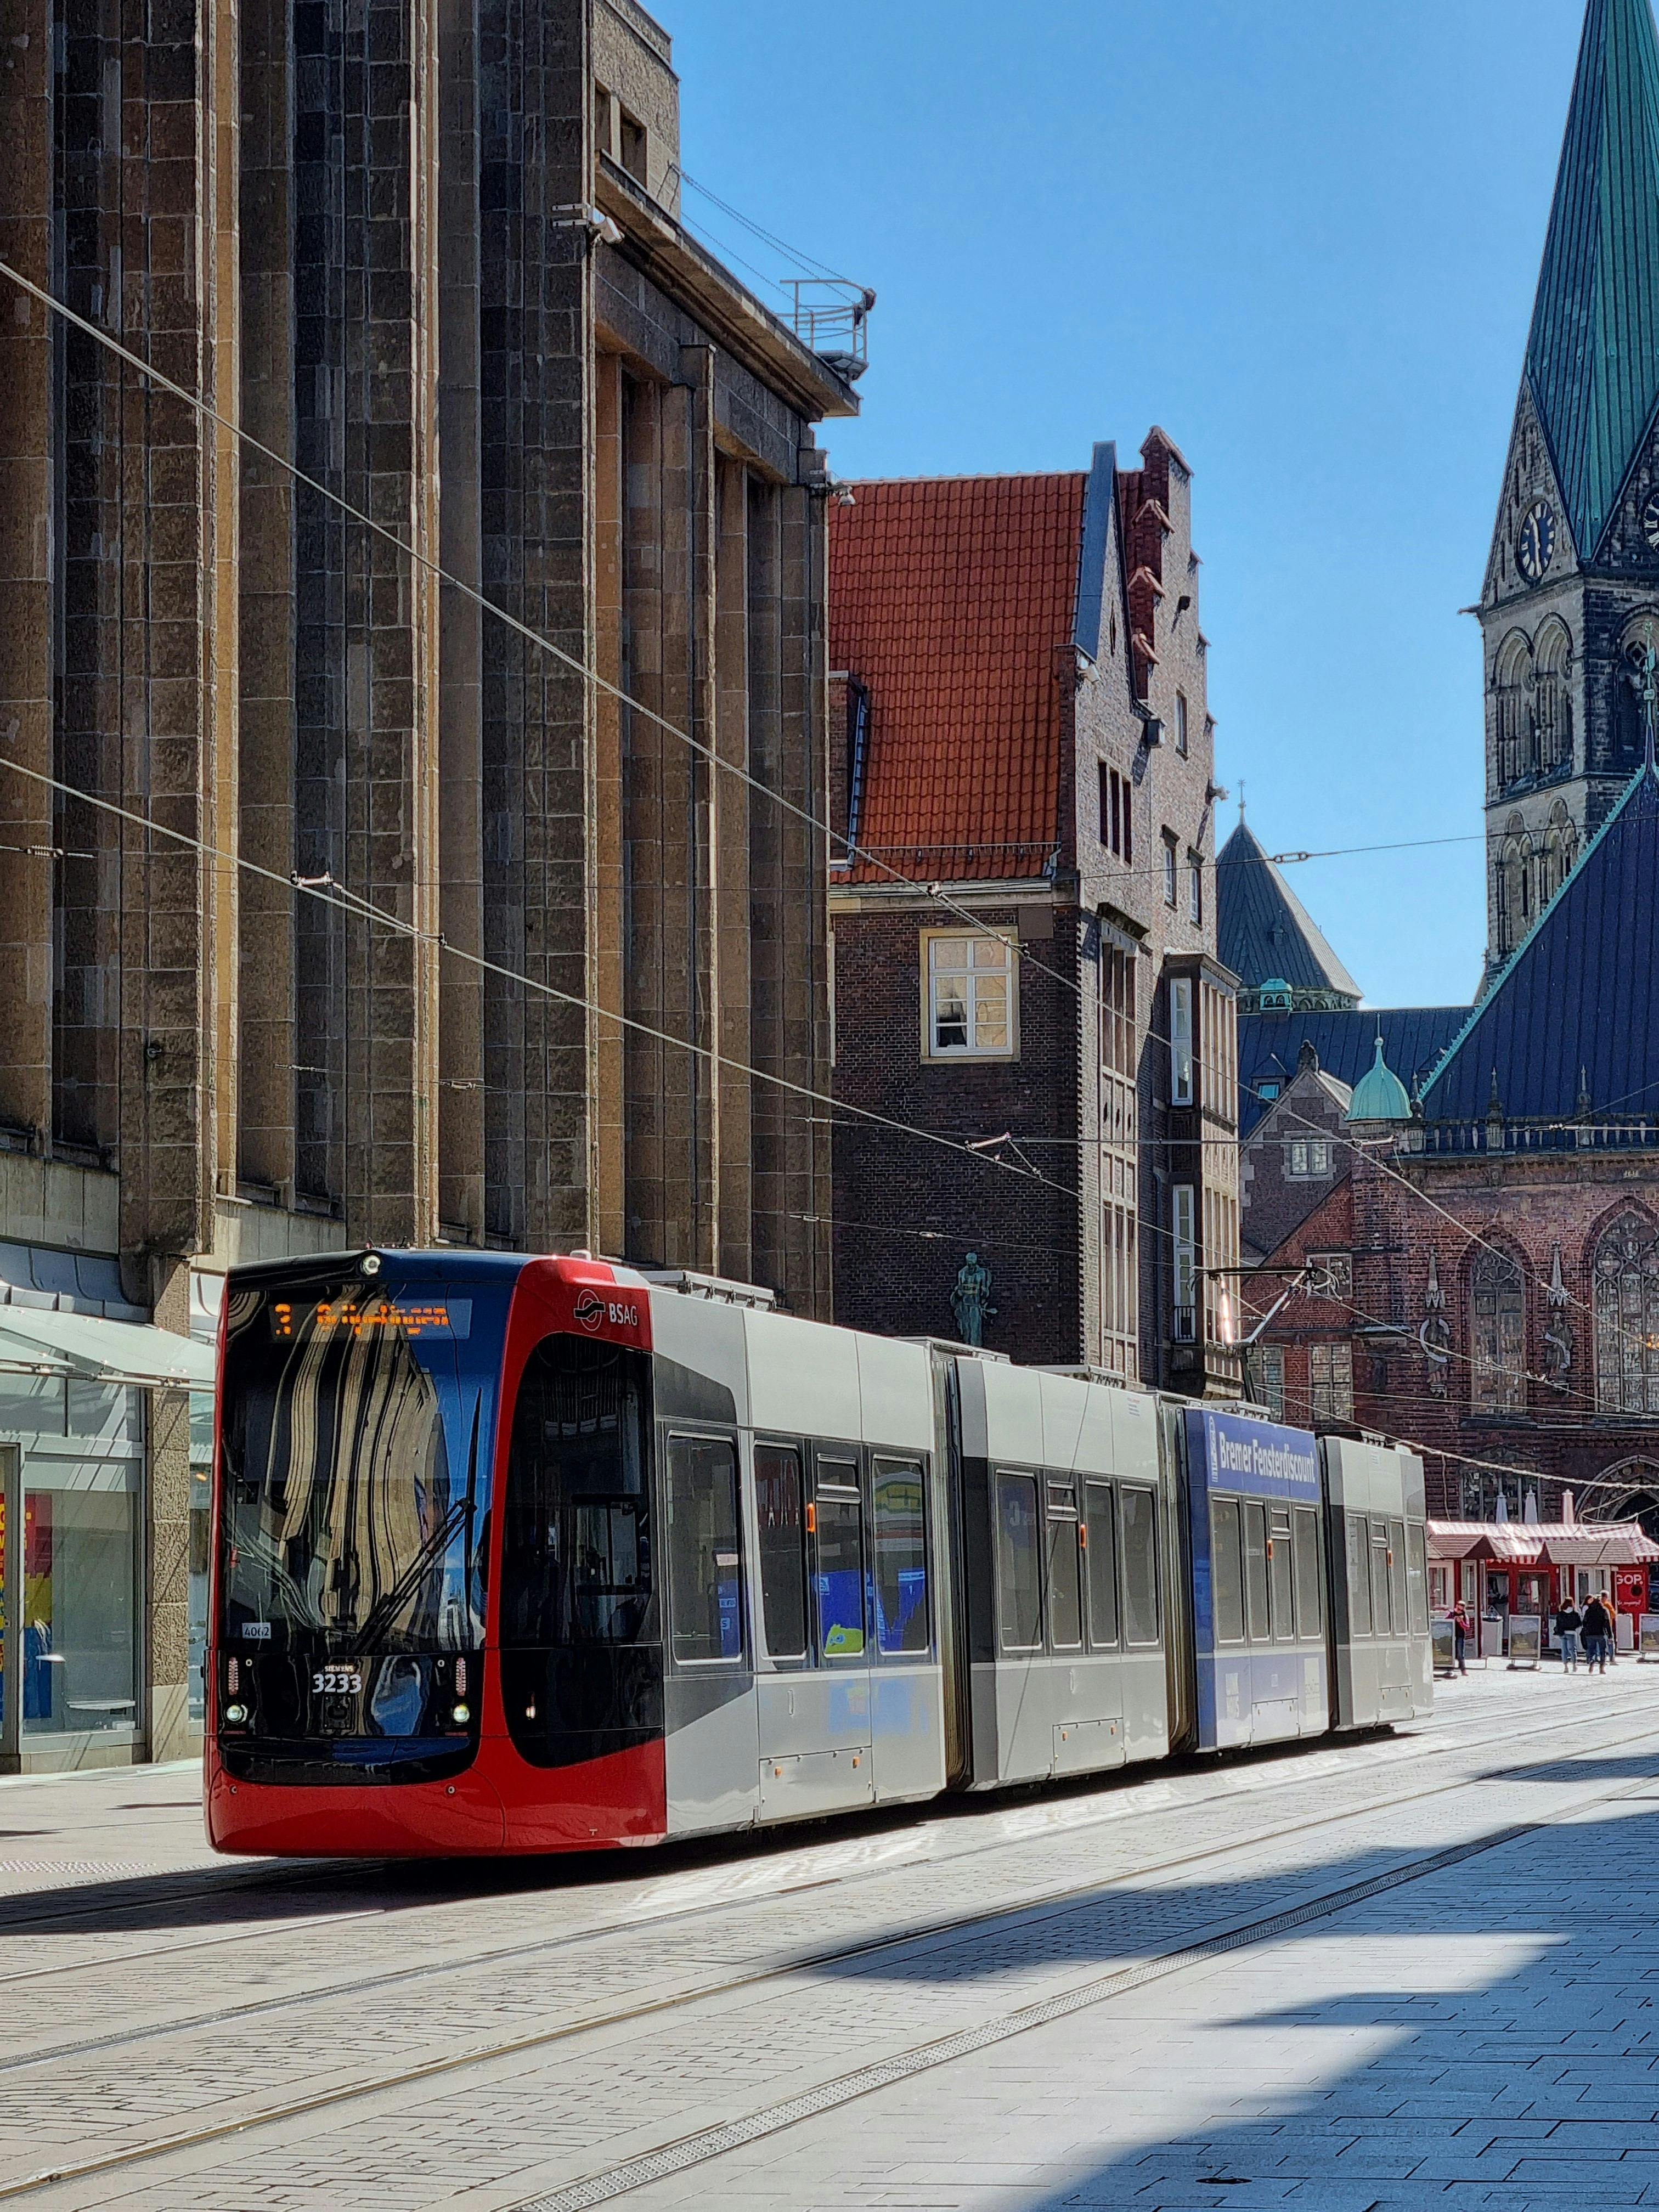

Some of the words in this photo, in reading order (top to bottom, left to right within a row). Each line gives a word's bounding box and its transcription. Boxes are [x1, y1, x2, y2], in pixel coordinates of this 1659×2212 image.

[608, 1302, 637, 1326] BSAG
[1219, 1431, 1251, 1472] Bremer
[1252, 1439, 1315, 1483] Fensterdiscount
[245, 1627, 269, 1637] 4062
[312, 1673, 362, 1694] 3233
